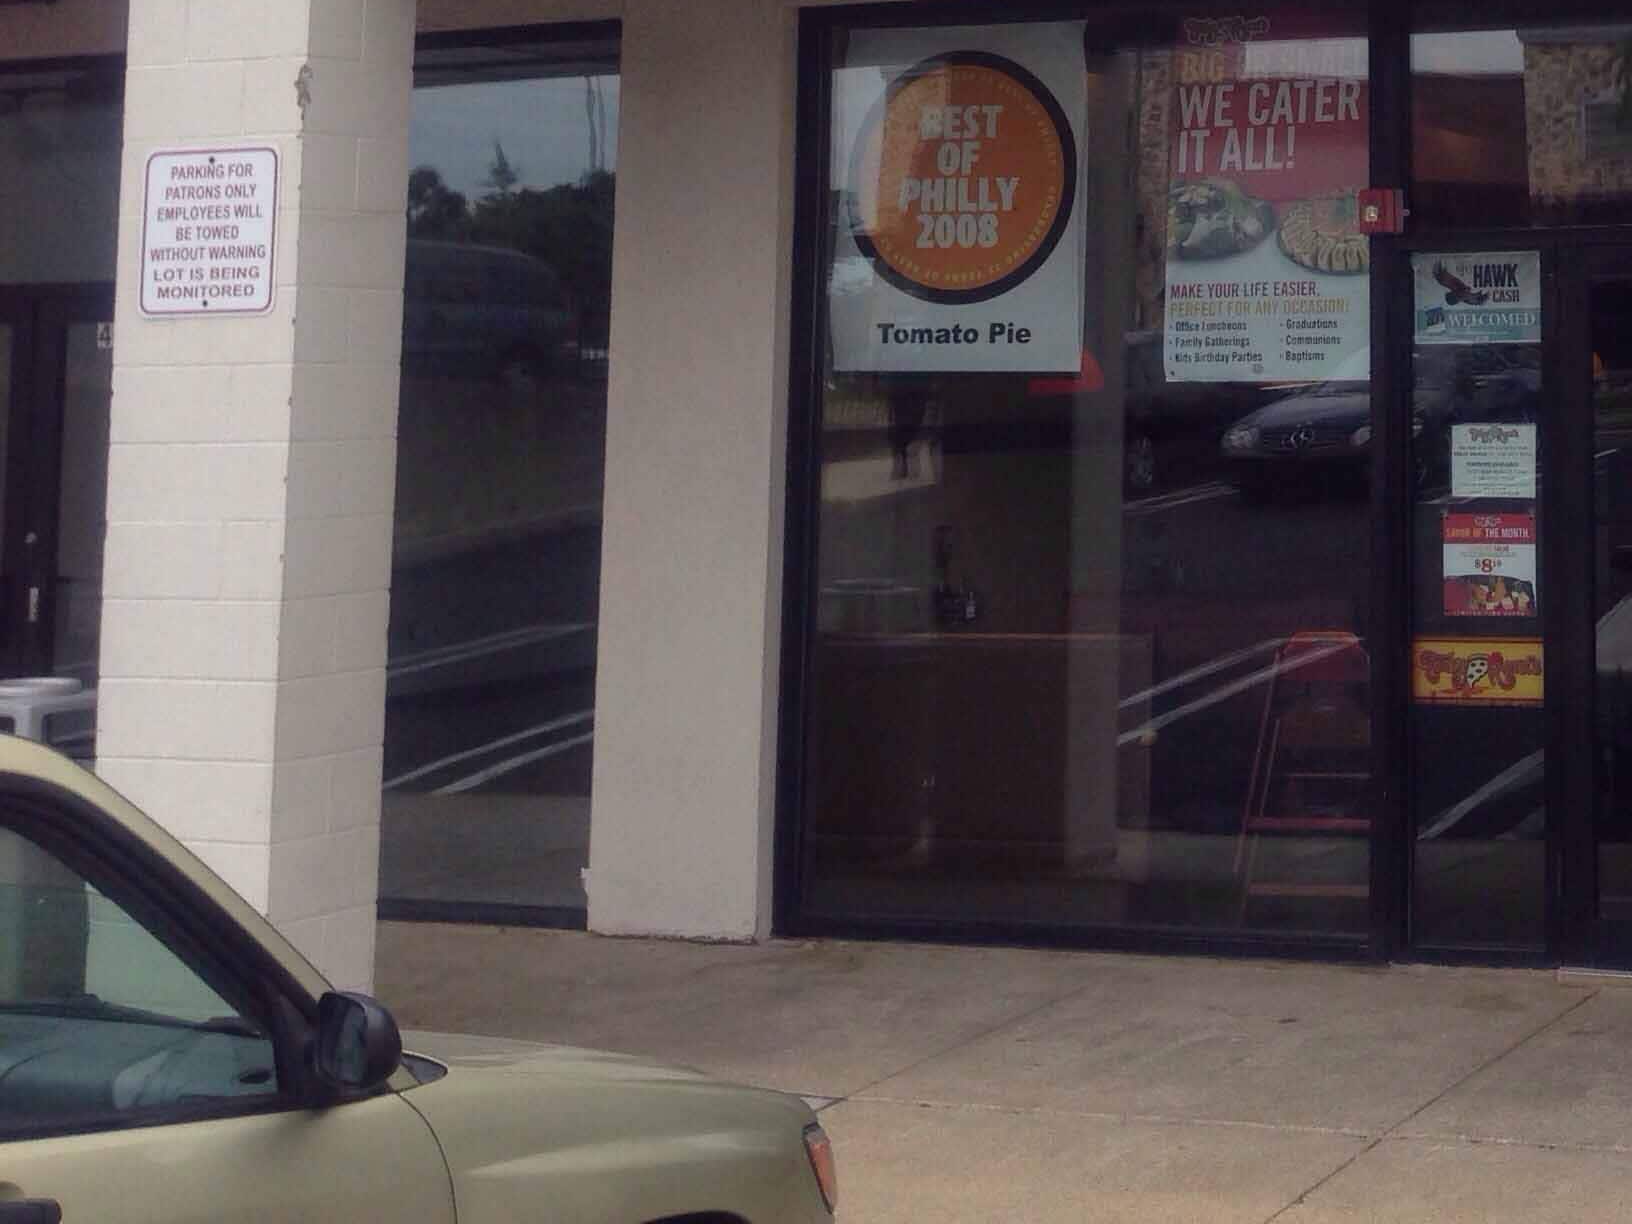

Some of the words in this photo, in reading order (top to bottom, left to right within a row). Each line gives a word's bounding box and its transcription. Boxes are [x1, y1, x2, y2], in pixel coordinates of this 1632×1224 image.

[1179, 84, 1234, 127] WE
[1248, 79, 1361, 125] CATER
[919, 105, 1004, 140] BEST
[1178, 130, 1210, 173] IT
[1220, 126, 1296, 171] ALL!
[937, 142, 981, 176] OF
[171, 163, 225, 180] PARKING
[228, 163, 253, 177] FOR
[165, 185, 221, 201] PATRONS
[225, 183, 257, 199] ONLY
[898, 176, 1021, 215] PHILLY
[157, 205, 231, 222] EMPLOYEES
[234, 204, 263, 218] WILL
[175, 226, 192, 242] BE
[196, 225, 239, 240] TOWED
[916, 214, 999, 249] 2008
[150, 246, 206, 262] WITHOUT
[208, 244, 266, 260] WARNING
[153, 268, 185, 282] LOT
[190, 267, 204, 281] IS
[210, 265, 260, 280] BEING
[1473, 263, 1519, 288] HAWK
[157, 284, 255, 300] MONITORED
[1170, 283, 1203, 299] MAKE
[1207, 282, 1239, 298] YOUR
[1243, 282, 1268, 297] LIFE
[1492, 289, 1520, 303] CASH
[1170, 301, 1223, 318] PERFECT
[1228, 300, 1250, 315] FOR
[1255, 299, 1280, 315] ANY
[1286, 318, 1338, 330] Graduations
[1448, 312, 1536, 329] WELCOMED
[878, 323, 979, 345] Tomato
[988, 322, 1032, 344] Pie
[1286, 335, 1341, 346] Communions
[1175, 336, 1203, 349] Family
[1205, 336, 1251, 348] Gatherings
[1232, 351, 1263, 362] Parties
[1285, 351, 1325, 363] Baptisms
